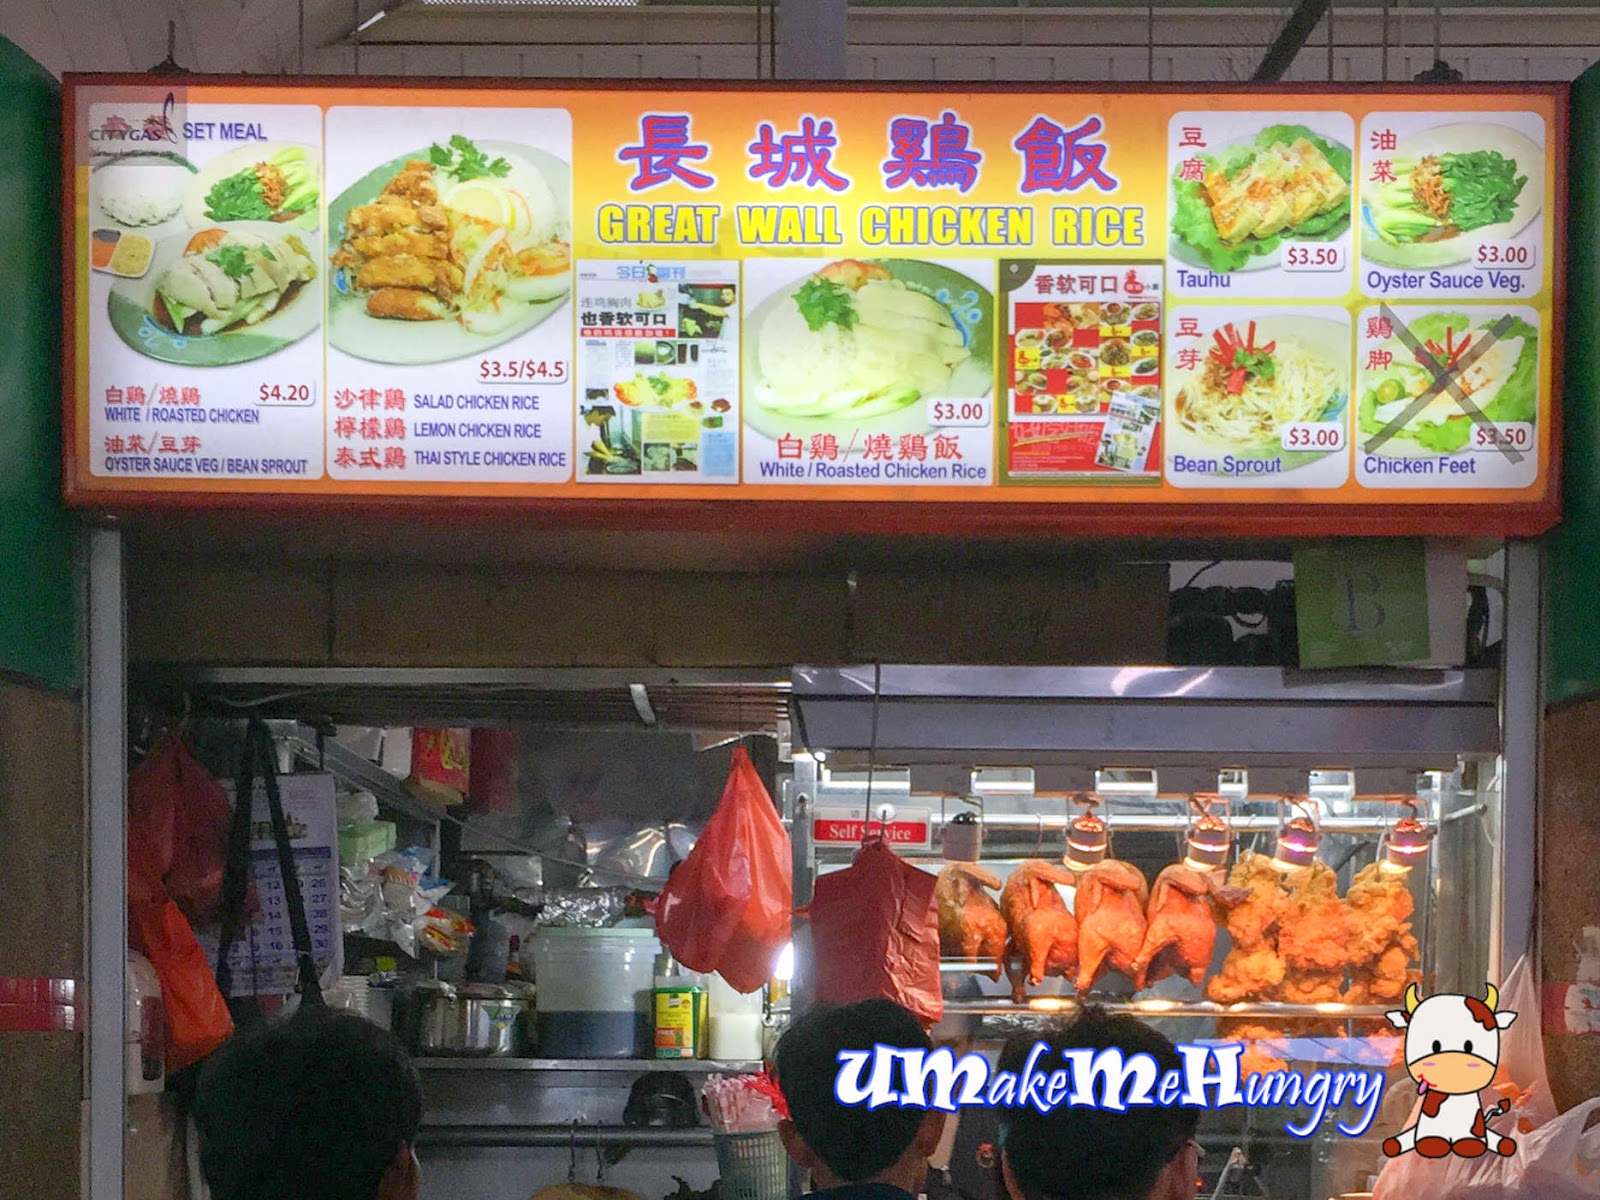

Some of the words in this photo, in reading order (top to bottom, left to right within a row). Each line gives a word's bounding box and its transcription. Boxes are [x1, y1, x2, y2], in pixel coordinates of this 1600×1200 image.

[183, 122, 216, 141] SET
[219, 123, 267, 142] MEAL
[1178, 127, 1207, 181] 豆腐
[1369, 129, 1398, 183] 油菜
[598, 204, 720, 246] GREAT
[737, 205, 842, 246] WALL
[860, 206, 1035, 246] CHICKEN
[1051, 206, 1144, 247] RICE
[1287, 246, 1338, 266] $3.50
[1477, 245, 1528, 263] $3.00
[1177, 270, 1231, 288] Tauhu
[1367, 270, 1426, 293] Oyster
[1429, 270, 1484, 290] Sauce
[1487, 271, 1526, 293] Veg.
[581, 311, 667, 327] 也香软可口
[1175, 317, 1203, 371] 豆芽
[480, 360, 564, 379] $3.5/$4.5
[259, 384, 310, 402] $4.20
[414, 394, 454, 410] SALAD
[457, 395, 510, 410] CHICKEN
[512, 395, 540, 411] RICE
[104, 407, 141, 422] WHITE
[152, 407, 206, 423] ROASTED
[209, 408, 260, 424] CHICKEN
[933, 403, 983, 421] $3.00
[414, 422, 456, 438] LEMON
[458, 423, 512, 438] CHICKEN
[514, 424, 542, 439] RICE
[1288, 427, 1339, 446] $3.00
[1476, 427, 1526, 446] $3.50
[105, 457, 151, 473] OYSTER
[153, 457, 193, 474] SAUCE
[195, 458, 219, 474] VEG
[227, 458, 259, 474] BEAN
[261, 459, 308, 475] SPROUT
[414, 451, 441, 465] THAI
[443, 451, 481, 466] STYLE
[483, 451, 537, 467] CHICKEN
[539, 452, 567, 467] RICE
[1173, 456, 1218, 473] Bean
[1223, 456, 1282, 477] Sprout
[1364, 456, 1433, 474] Chicken
[1438, 457, 1476, 474] Feet
[760, 462, 804, 478] White
[815, 462, 880, 479] Roasted
[884, 462, 947, 479] Chicken
[952, 463, 987, 479] Rice
[1341, 570, 1386, 633] B
[829, 823, 857, 839] Self
